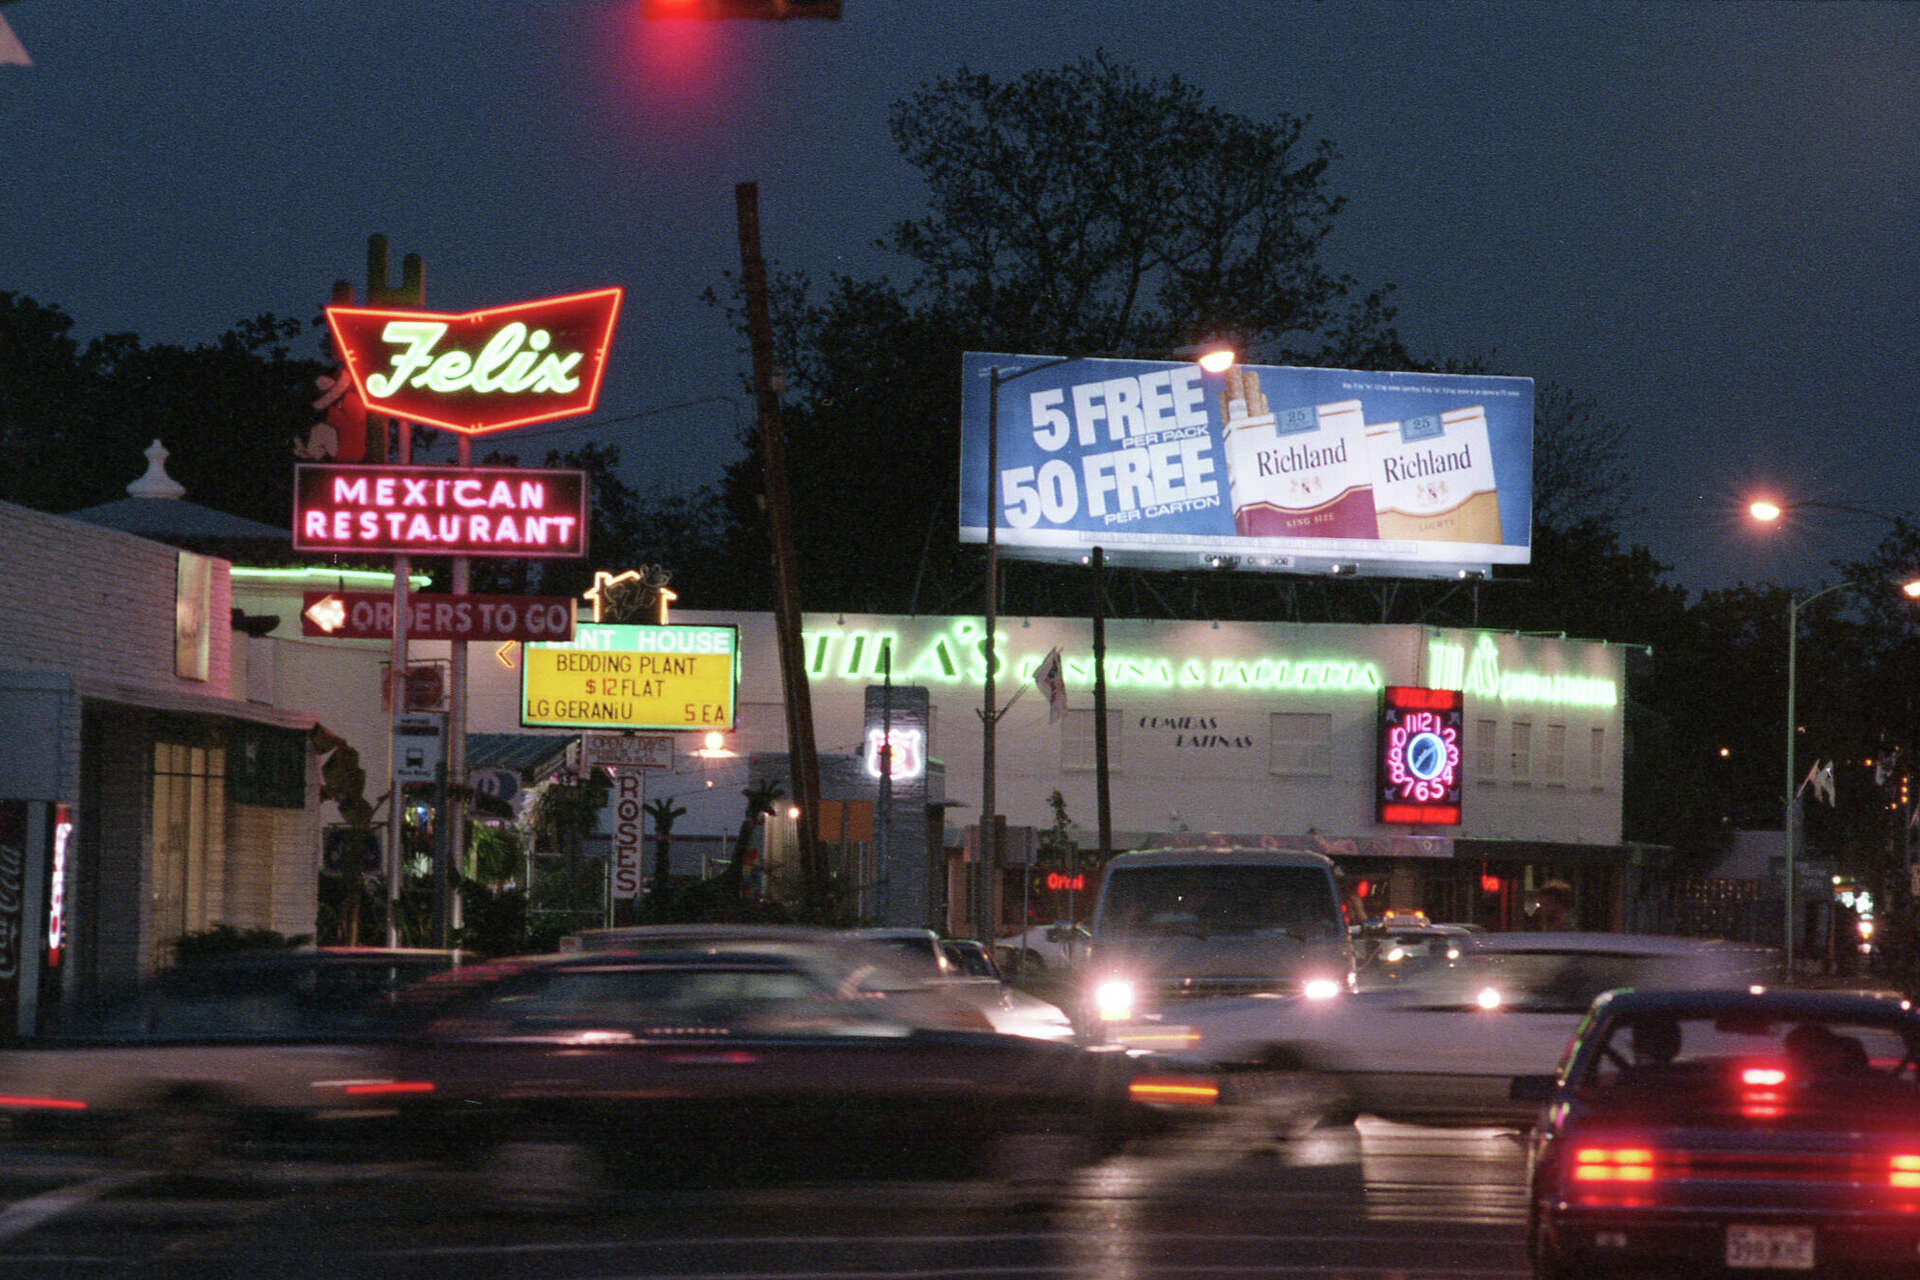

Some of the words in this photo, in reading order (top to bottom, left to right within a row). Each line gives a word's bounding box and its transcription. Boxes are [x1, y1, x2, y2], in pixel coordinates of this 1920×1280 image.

[366, 321, 584, 398] Felix
[1029, 388, 1071, 452] 5
[1072, 366, 1209, 447] FREE
[1121, 432, 1158, 450] PER
[1162, 424, 1210, 445] PACK
[1257, 437, 1348, 477] Richland
[1383, 443, 1472, 483] Richland
[333, 476, 545, 509] MEXICAN
[1001, 458, 1079, 529] 50
[1082, 436, 1218, 518] FREE
[1104, 508, 1141, 526] PER
[1144, 496, 1221, 519] CARTON
[304, 510, 575, 544] RESTAURANT
[479, 603, 517, 632] TO
[525, 604, 568, 633] GO
[638, 631, 731, 653] HOUSE
[556, 653, 632, 673] BEDDING
[640, 656, 697, 676] PLANT
[1016, 654, 1171, 685] CNINA
[1210, 658, 1382, 688] TAQUERIA
[621, 680, 665, 697] FLAT
[527, 699, 549, 718] LG
[684, 704, 696, 722] 5
[702, 705, 725, 723] EA
[1418, 712, 1432, 731] 12
[1391, 727, 1407, 748] 10
[1443, 728, 1456, 746] 2
[1388, 747, 1402, 765] 9
[1446, 744, 1459, 767] 3
[1391, 762, 1404, 783] 8
[1441, 765, 1453, 786] 4
[1403, 776, 1414, 798] 7
[1415, 781, 1429, 801] 6
[1430, 777, 1444, 799] 5
[616, 775, 640, 893] ROSES
